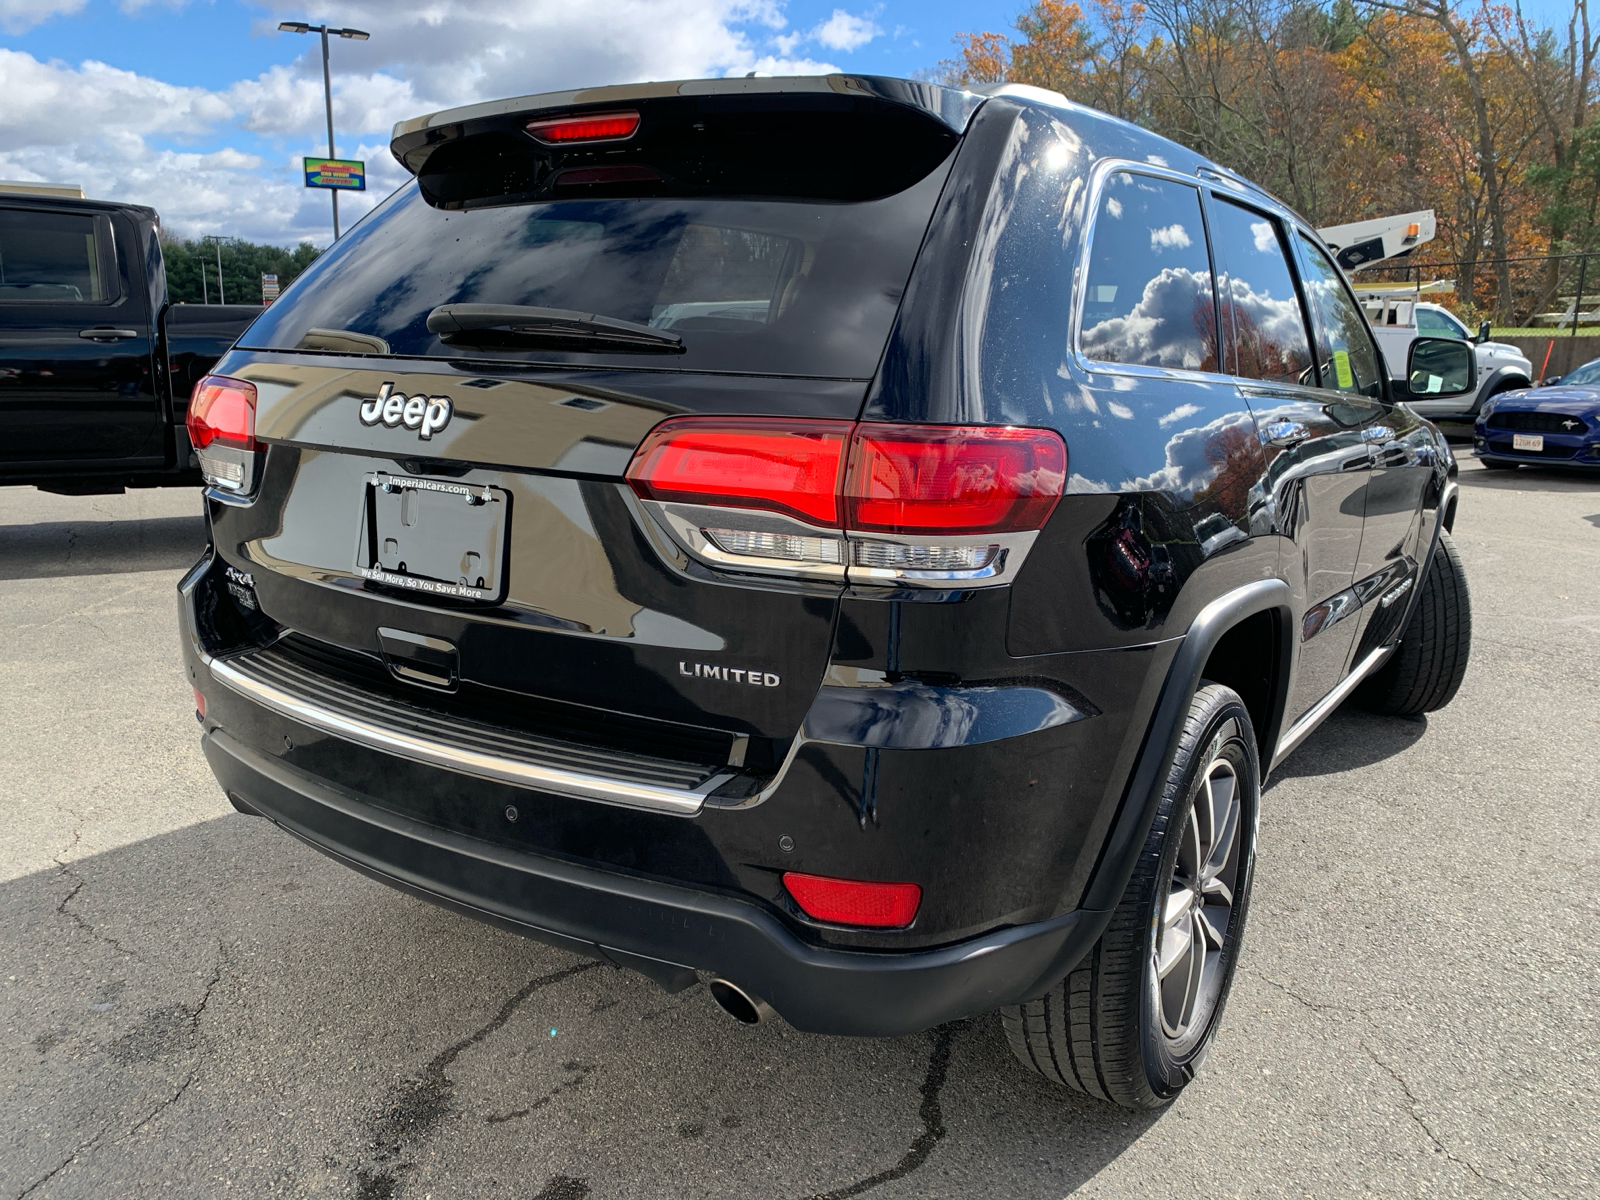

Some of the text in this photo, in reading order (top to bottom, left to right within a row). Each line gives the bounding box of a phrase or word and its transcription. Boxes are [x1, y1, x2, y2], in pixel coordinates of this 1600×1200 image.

[359, 381, 454, 441] Jeep
[388, 475, 470, 495] Imperialcars.com
[361, 568, 482, 598] We Sell More, So You Save More
[679, 660, 781, 688] LIMITED
